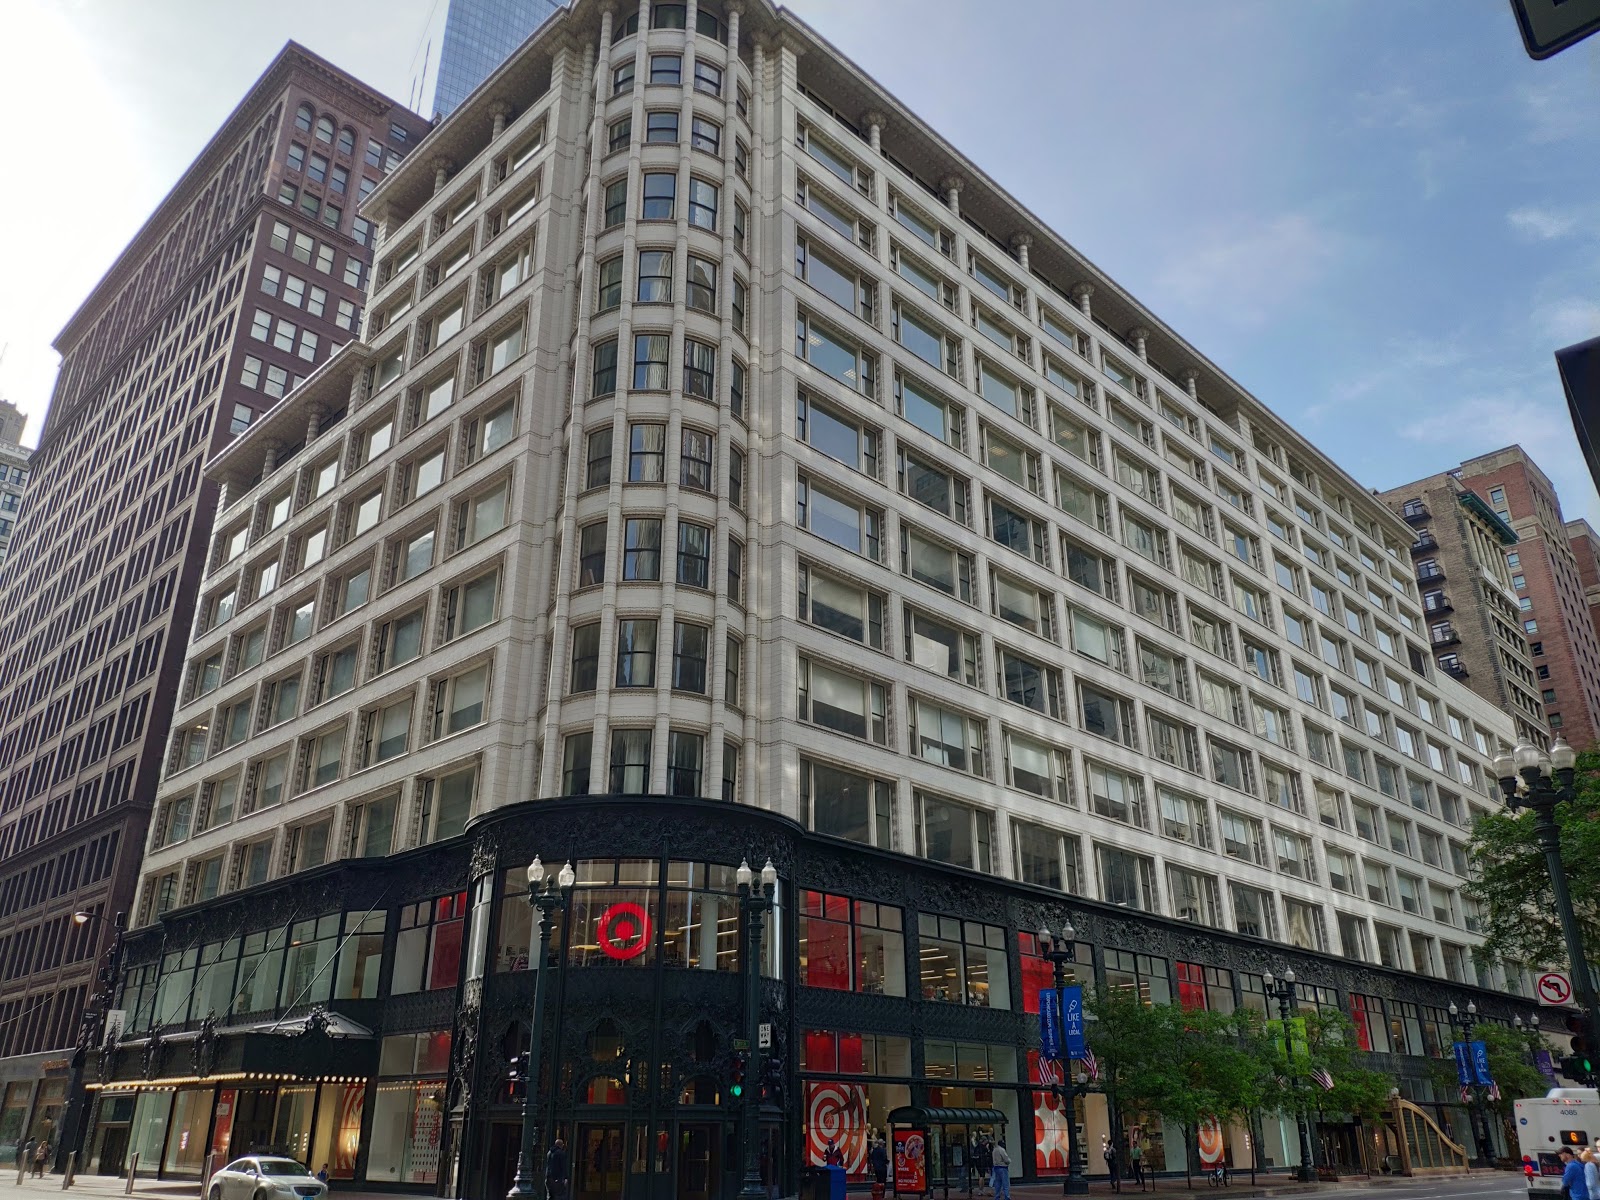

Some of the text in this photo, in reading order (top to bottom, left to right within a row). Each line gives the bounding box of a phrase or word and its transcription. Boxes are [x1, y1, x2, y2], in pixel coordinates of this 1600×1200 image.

[1067, 1013, 1080, 1021] LIKE
[1071, 1021, 1077, 1029] A
[1570, 1132, 1578, 1143] 6
